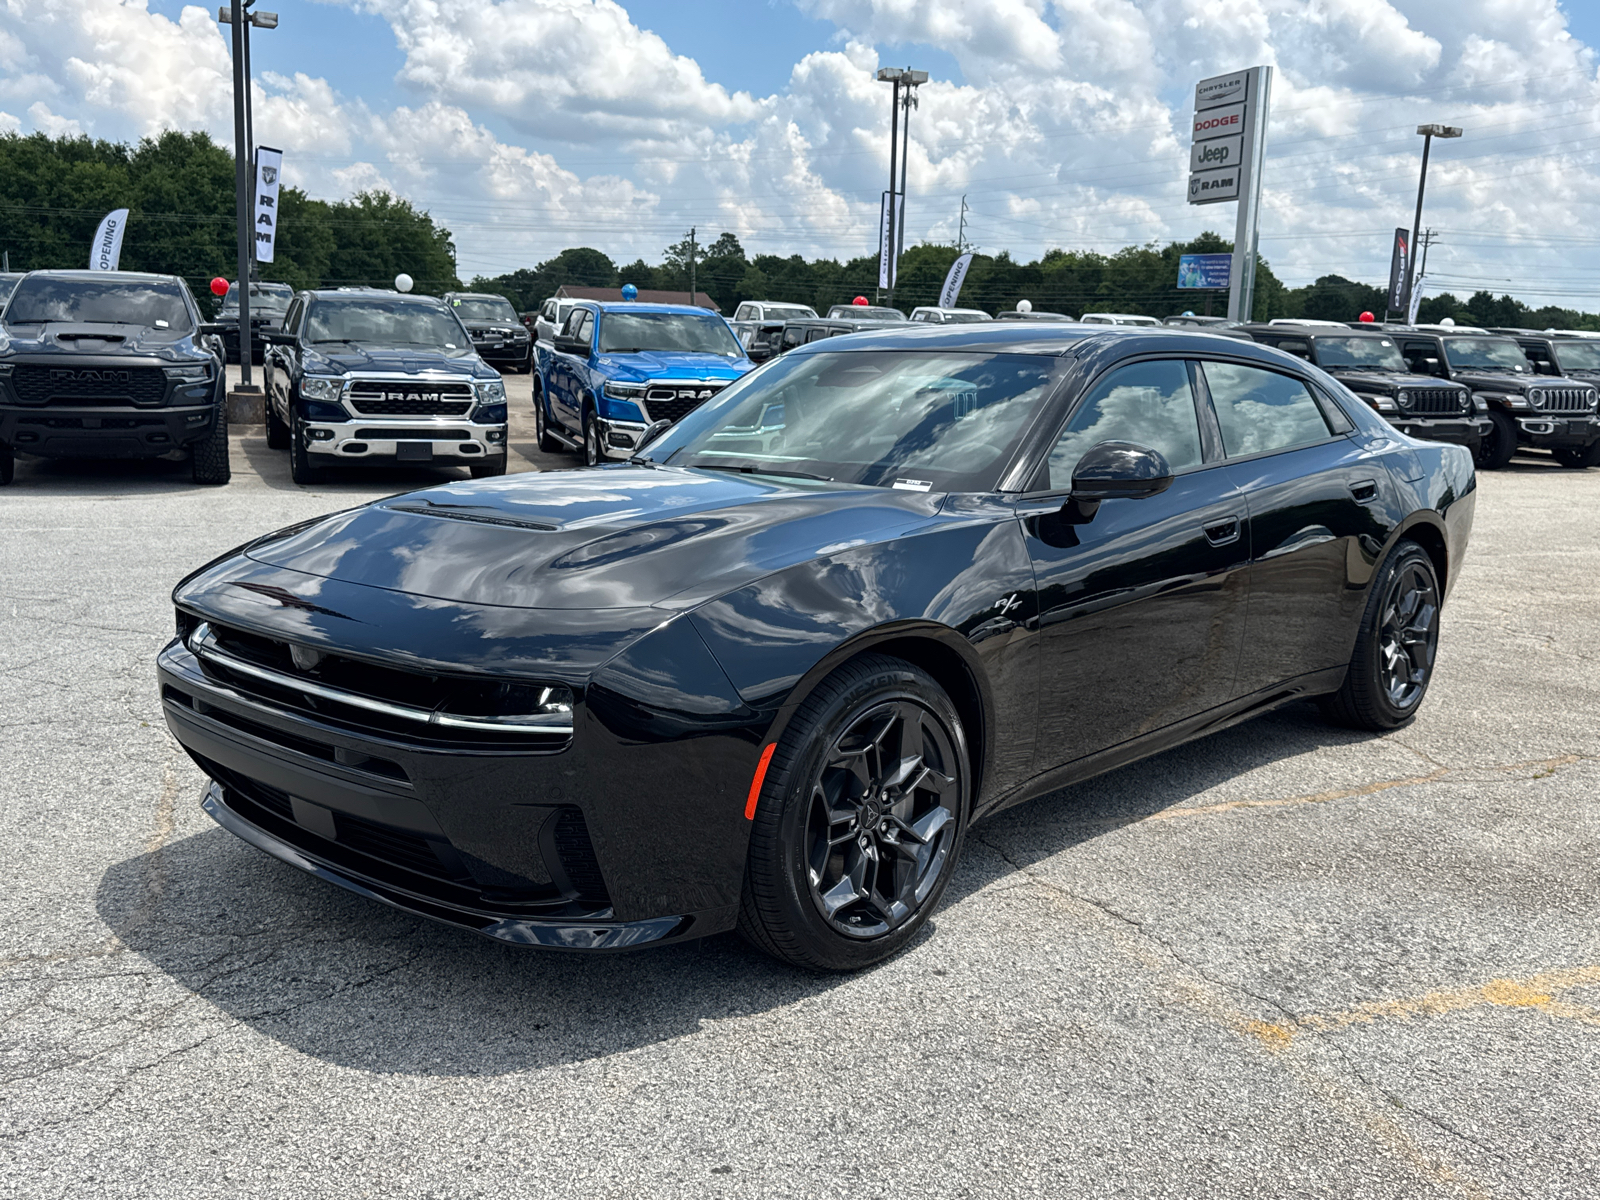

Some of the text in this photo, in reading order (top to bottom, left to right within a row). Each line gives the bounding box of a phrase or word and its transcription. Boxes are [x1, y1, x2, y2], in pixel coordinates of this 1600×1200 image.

[1198, 80, 1240, 94] CHRYSLER
[1195, 114, 1239, 132] DODGE
[1198, 145, 1229, 163] Jeep
[1201, 178, 1234, 191] RAM
[256, 194, 274, 243] RAM
[100, 219, 117, 270] OPENING
[944, 261, 964, 305] OPENING
[50, 369, 129, 381] RAM
[388, 392, 438, 401] RAM
[678, 389, 718, 399] RA
[994, 593, 1023, 615] R/T
[843, 673, 899, 707] NEXEN
